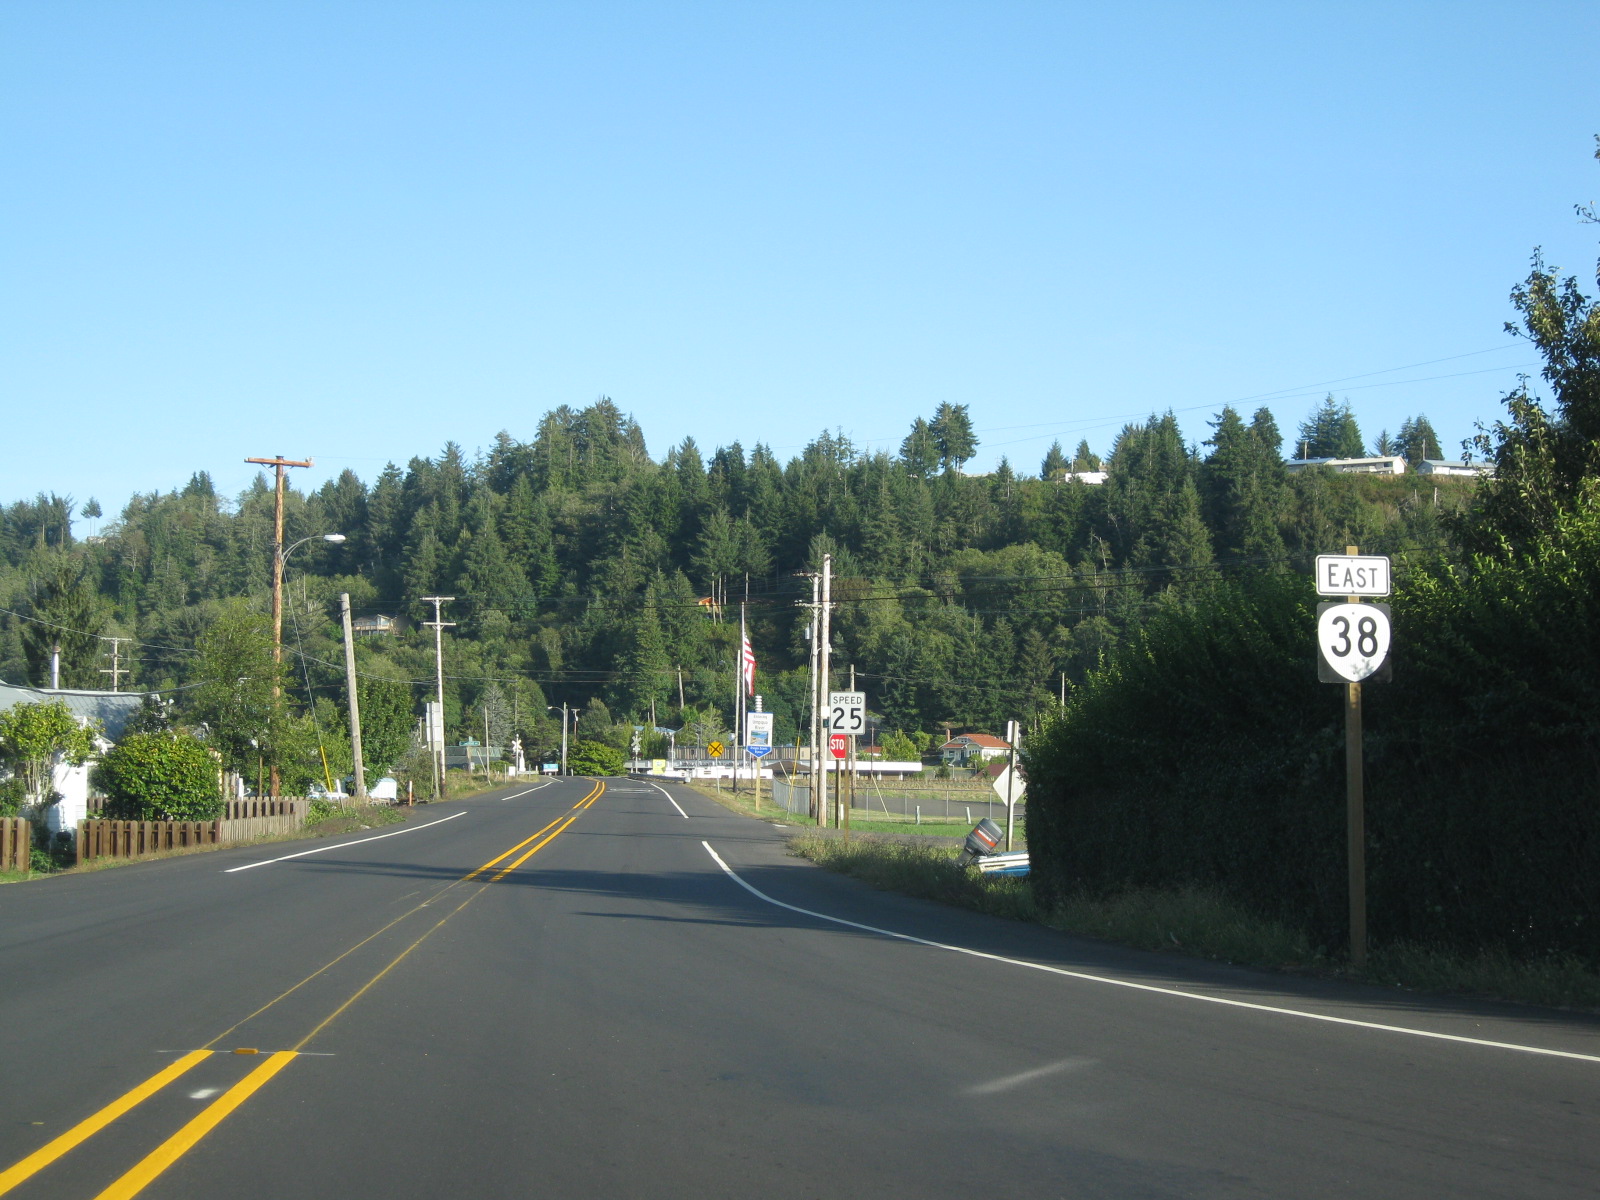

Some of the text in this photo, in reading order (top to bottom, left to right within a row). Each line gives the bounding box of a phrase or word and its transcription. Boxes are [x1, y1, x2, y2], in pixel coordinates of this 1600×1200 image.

[1328, 564, 1378, 588] EAST
[1331, 615, 1378, 657] 38
[833, 696, 862, 704] SPEED
[832, 707, 862, 730] 25
[830, 738, 848, 750] STO
